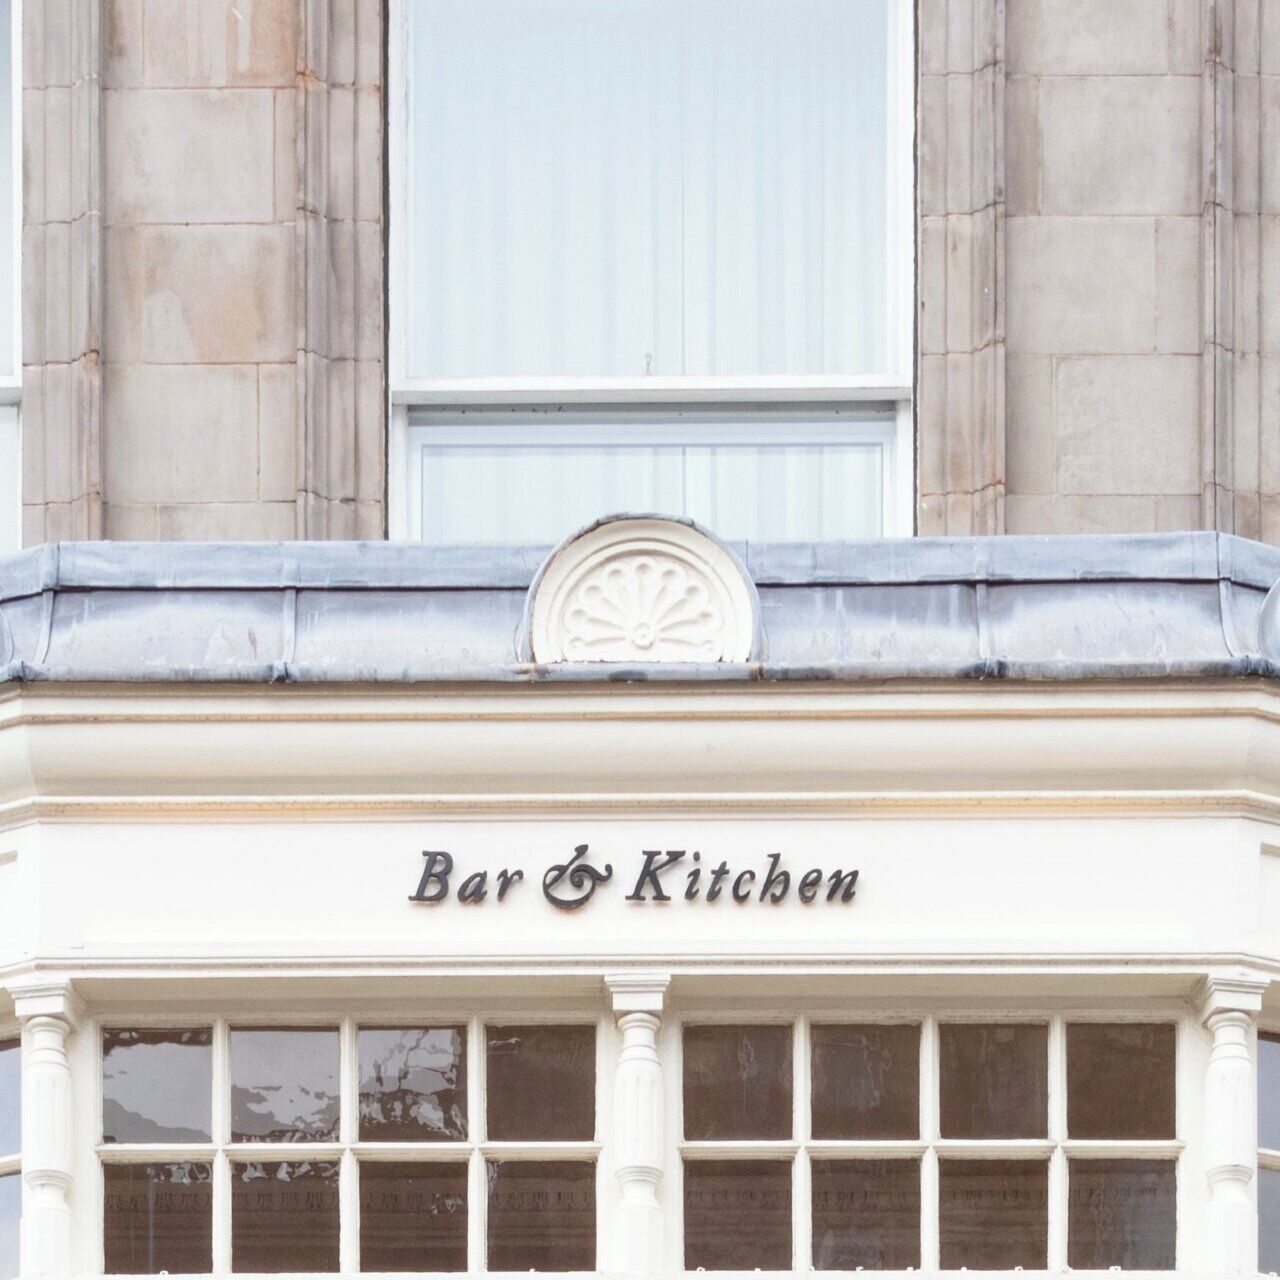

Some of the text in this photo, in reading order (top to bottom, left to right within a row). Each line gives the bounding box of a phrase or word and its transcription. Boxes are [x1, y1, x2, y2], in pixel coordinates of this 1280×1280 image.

[408, 844, 860, 910] Bar & Kitchen
